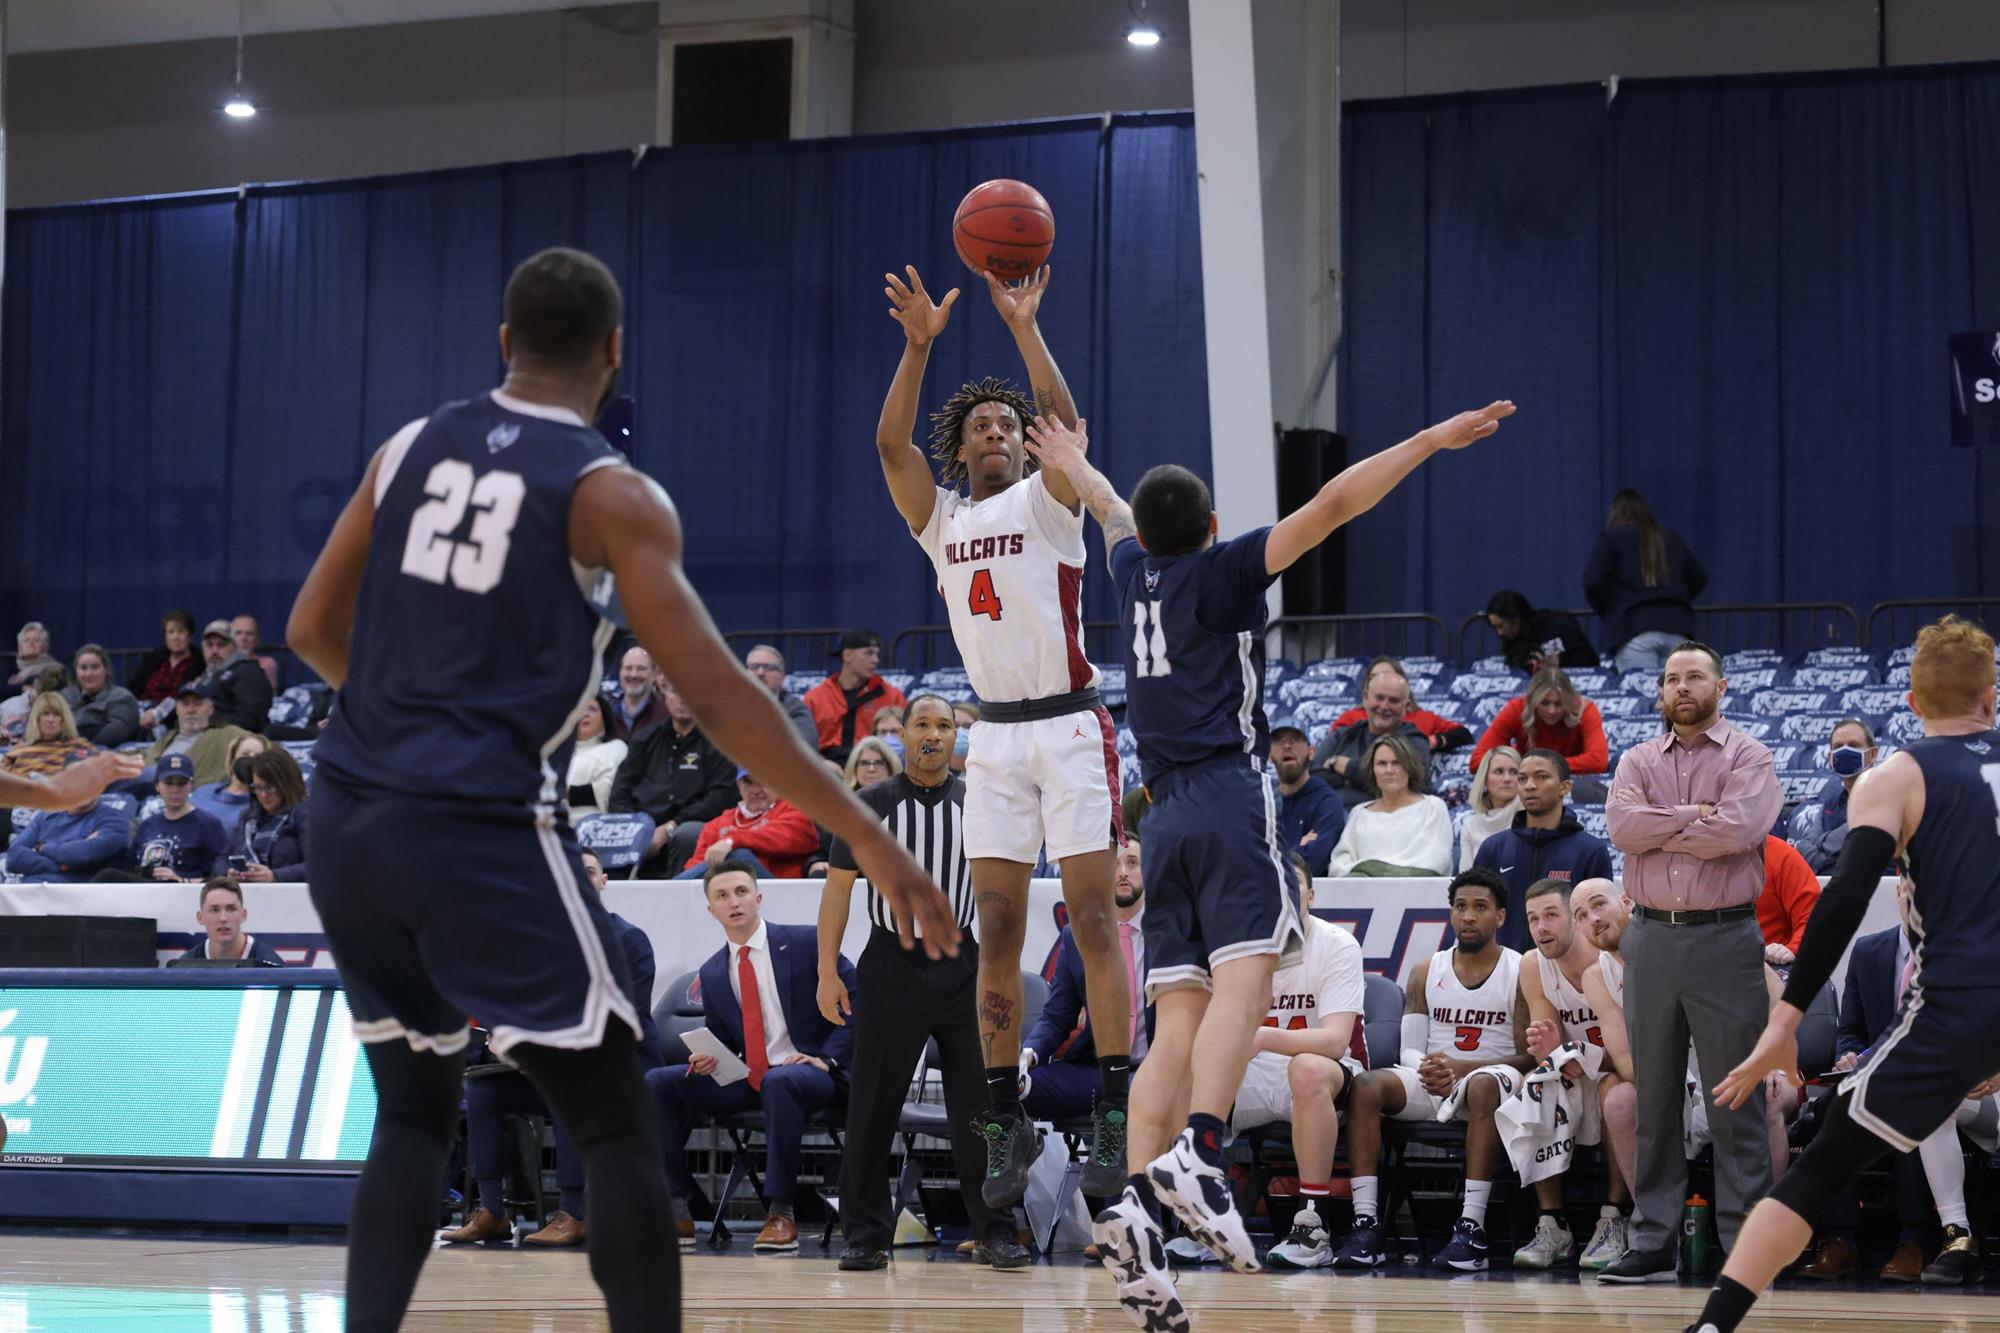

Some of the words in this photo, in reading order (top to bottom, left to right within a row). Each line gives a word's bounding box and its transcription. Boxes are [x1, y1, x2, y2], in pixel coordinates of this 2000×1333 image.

[1975, 378, 2000, 402] S
[401, 458, 527, 594] 23
[968, 569, 1003, 621] 4
[1133, 600, 1172, 678] 11
[1270, 994, 1316, 1010] LCATS
[1433, 1007, 1507, 1026] HILLCATS
[1455, 1026, 1482, 1051] 3
[3, 1155, 64, 1164] DAKTRONICS
[1535, 1136, 1576, 1162] GATO
